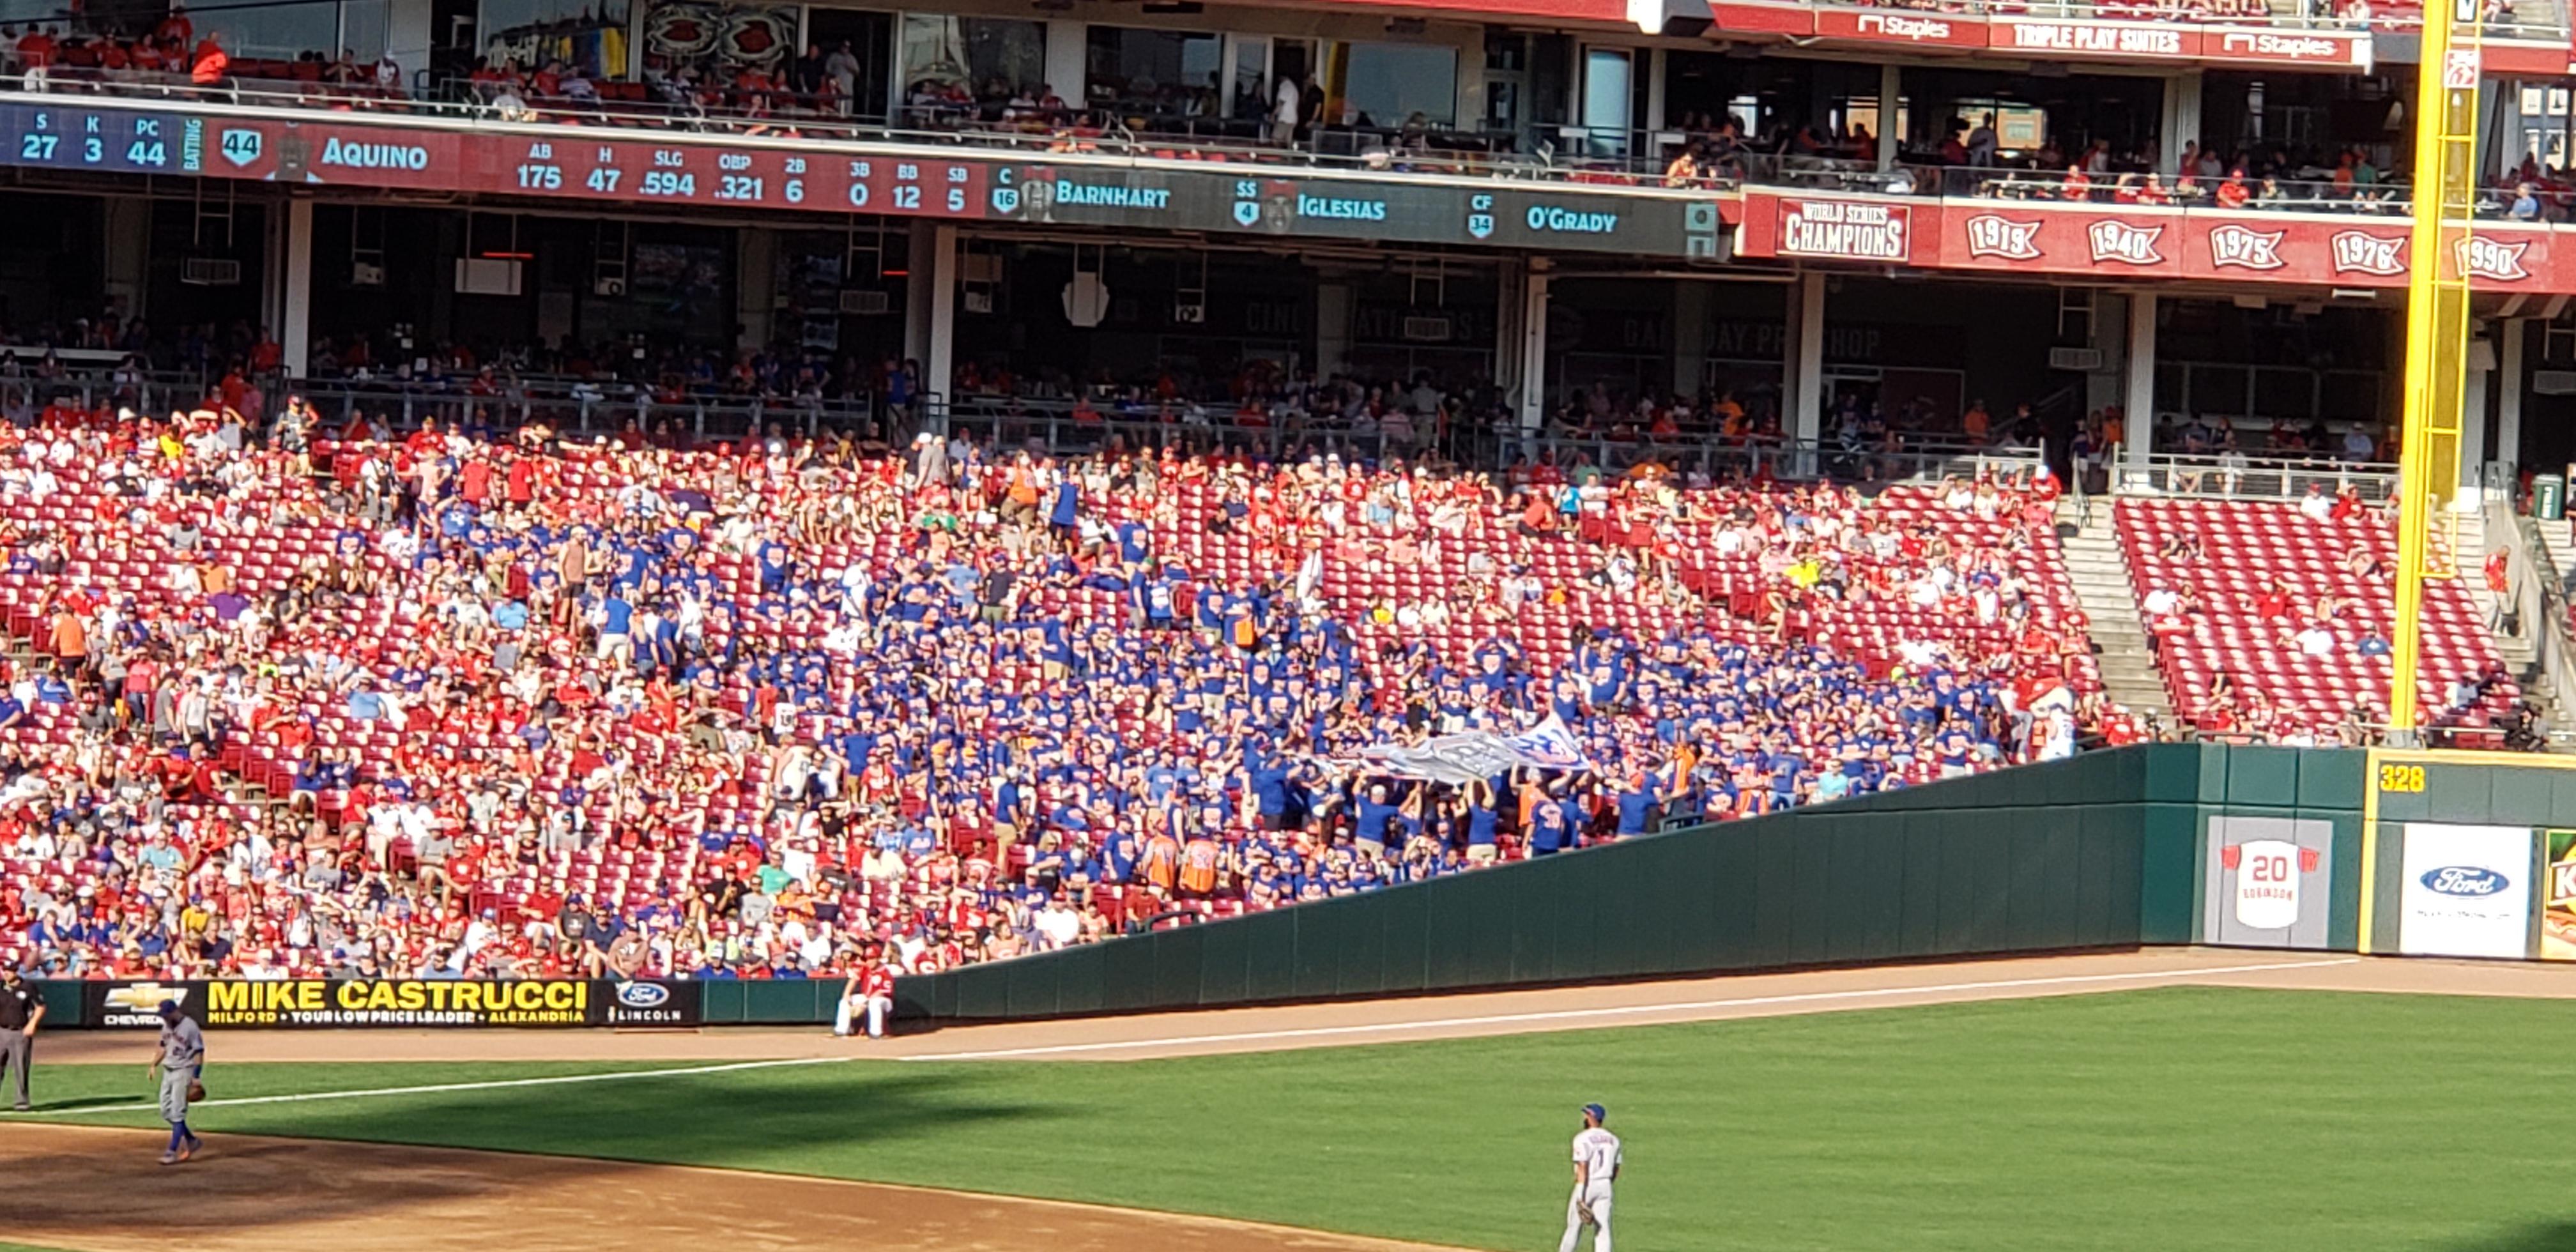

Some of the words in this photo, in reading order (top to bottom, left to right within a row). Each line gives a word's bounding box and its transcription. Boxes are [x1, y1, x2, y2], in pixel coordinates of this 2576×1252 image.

[1885, 16, 1951, 40] Staples
[2014, 24, 2073, 48] TRIPLE
[2074, 26, 2118, 49] PLAY
[2119, 29, 2180, 53] SUITES
[2257, 35, 2336, 57] Staples
[37, 114, 47, 129] S
[87, 116, 98, 132] K
[137, 119, 158, 135] PC
[23, 135, 58, 159] 27
[86, 138, 102, 162] 3
[128, 142, 165, 165] 44
[183, 119, 202, 171] BATTING
[224, 133, 257, 155] 44
[322, 137, 427, 170] AQUINO
[530, 144, 551, 159] AB
[599, 148, 611, 162] H
[655, 151, 683, 167] SLG
[719, 155, 751, 170] OBP
[785, 158, 806, 174] 2B
[851, 162, 870, 178] 3B
[518, 165, 562, 189] 175
[587, 169, 620, 191] 47
[898, 164, 917, 179] BB
[949, 167, 967, 183] SB
[1000, 168, 1011, 184] C
[640, 172, 695, 196] .594
[714, 176, 762, 199] .321
[786, 180, 803, 202] 6
[850, 183, 868, 205] 0
[1056, 179, 1170, 208] BARNHART
[1237, 181, 1257, 197] SS
[893, 186, 921, 208] 12
[948, 189, 965, 211] 5
[999, 192, 1015, 204] 16
[1298, 194, 1385, 220] IGLESIAS
[1471, 195, 1492, 210] CF
[1241, 204, 1251, 218] 4
[1528, 206, 1617, 233] O'GRADY
[1802, 202, 1844, 222] WORLD
[1846, 204, 1888, 224] SERIES
[1786, 213, 1903, 257] CHAMPIONS
[1974, 218, 2025, 254] 1919
[2094, 224, 2147, 259] 1940
[2216, 231, 2268, 263] 1975
[2338, 235, 2392, 270] 1976
[2460, 241, 2512, 275] 1990
[2380, 765, 2425, 793] 328
[2253, 855, 2287, 882] 20
[2434, 867, 2496, 894] Ford
[208, 982, 326, 1010] MIKE
[337, 981, 586, 1009] CASTRUCCI
[208, 1012, 277, 1023] MILFORD
[291, 1011, 333, 1023] YOUR
[334, 1011, 369, 1022] LOW
[371, 1011, 415, 1022] PRICE
[417, 1011, 475, 1023] LEADER
[489, 1011, 584, 1022] ALEXANDRIA
[618, 1010, 681, 1020] LINCOLN
